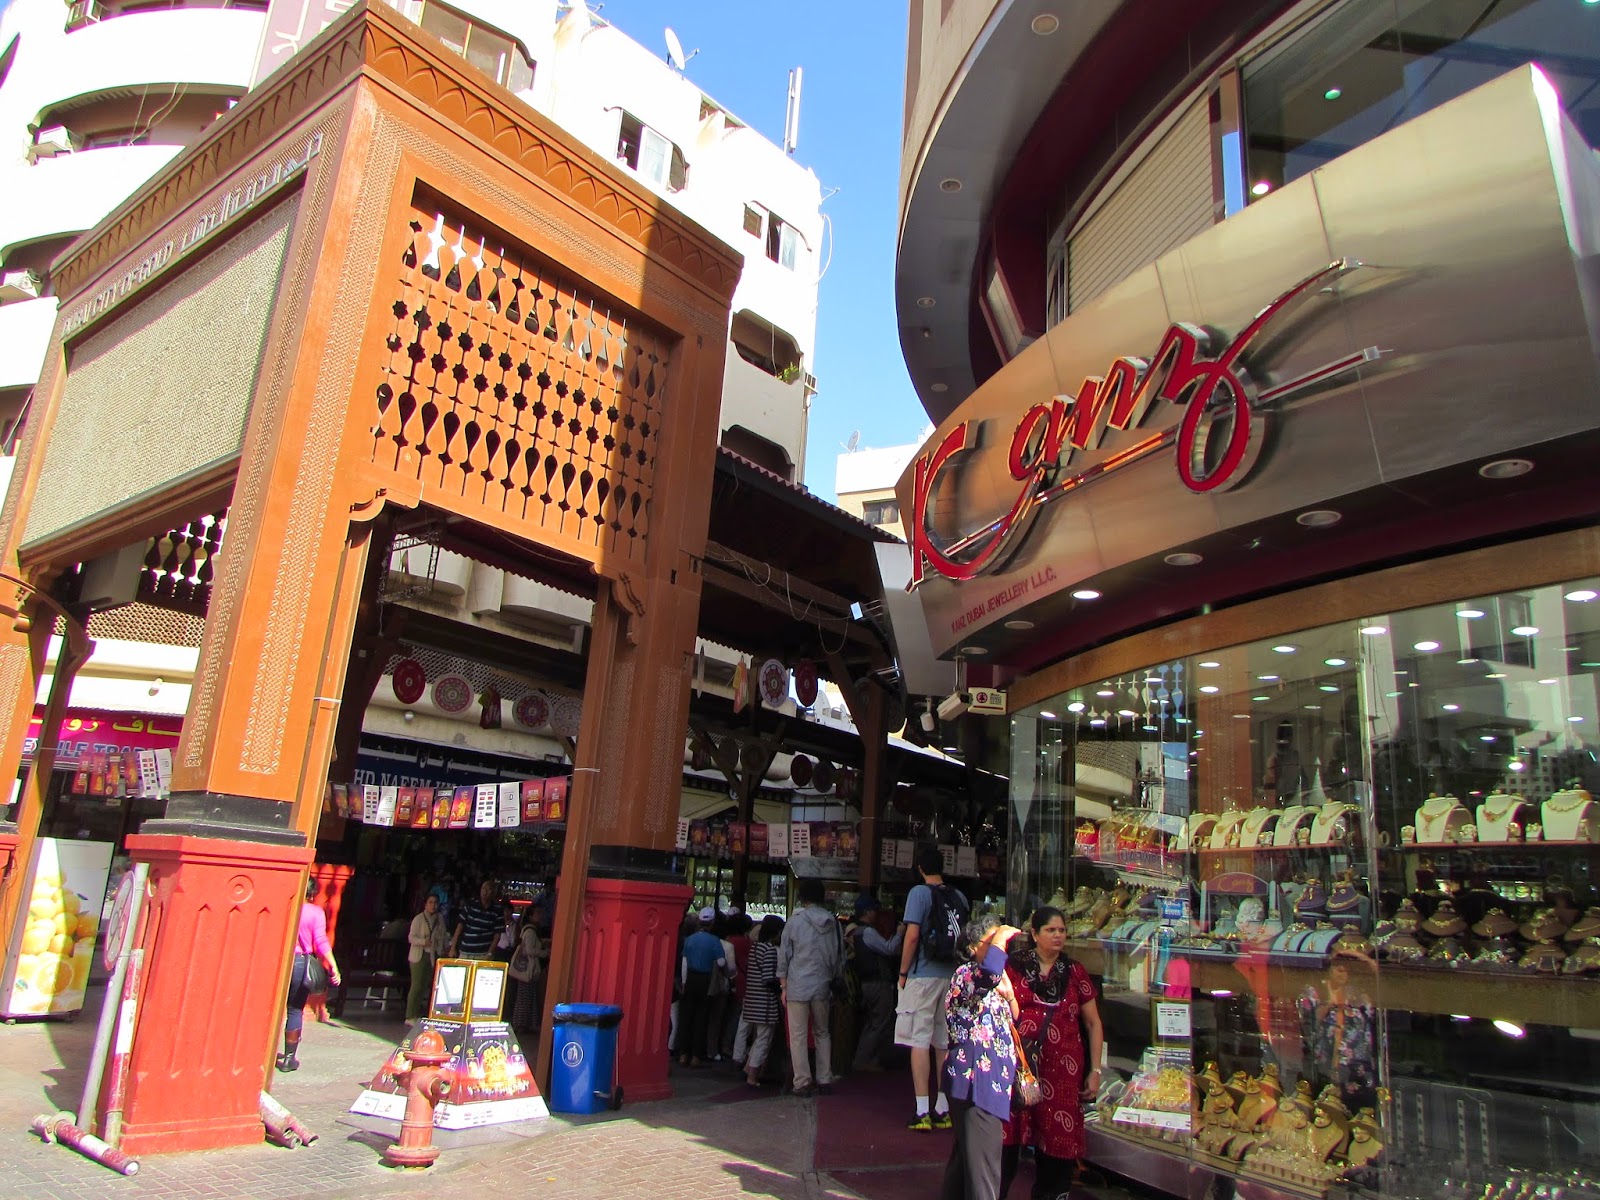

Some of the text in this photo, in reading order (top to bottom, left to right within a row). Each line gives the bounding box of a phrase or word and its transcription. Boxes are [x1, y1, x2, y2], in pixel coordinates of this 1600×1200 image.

[91, 282, 118, 317] CITY
[120, 267, 140, 296] OF
[137, 241, 173, 284] GOLD
[967, 603, 985, 624] DUBAI
[987, 580, 1029, 613] JEWELLERY
